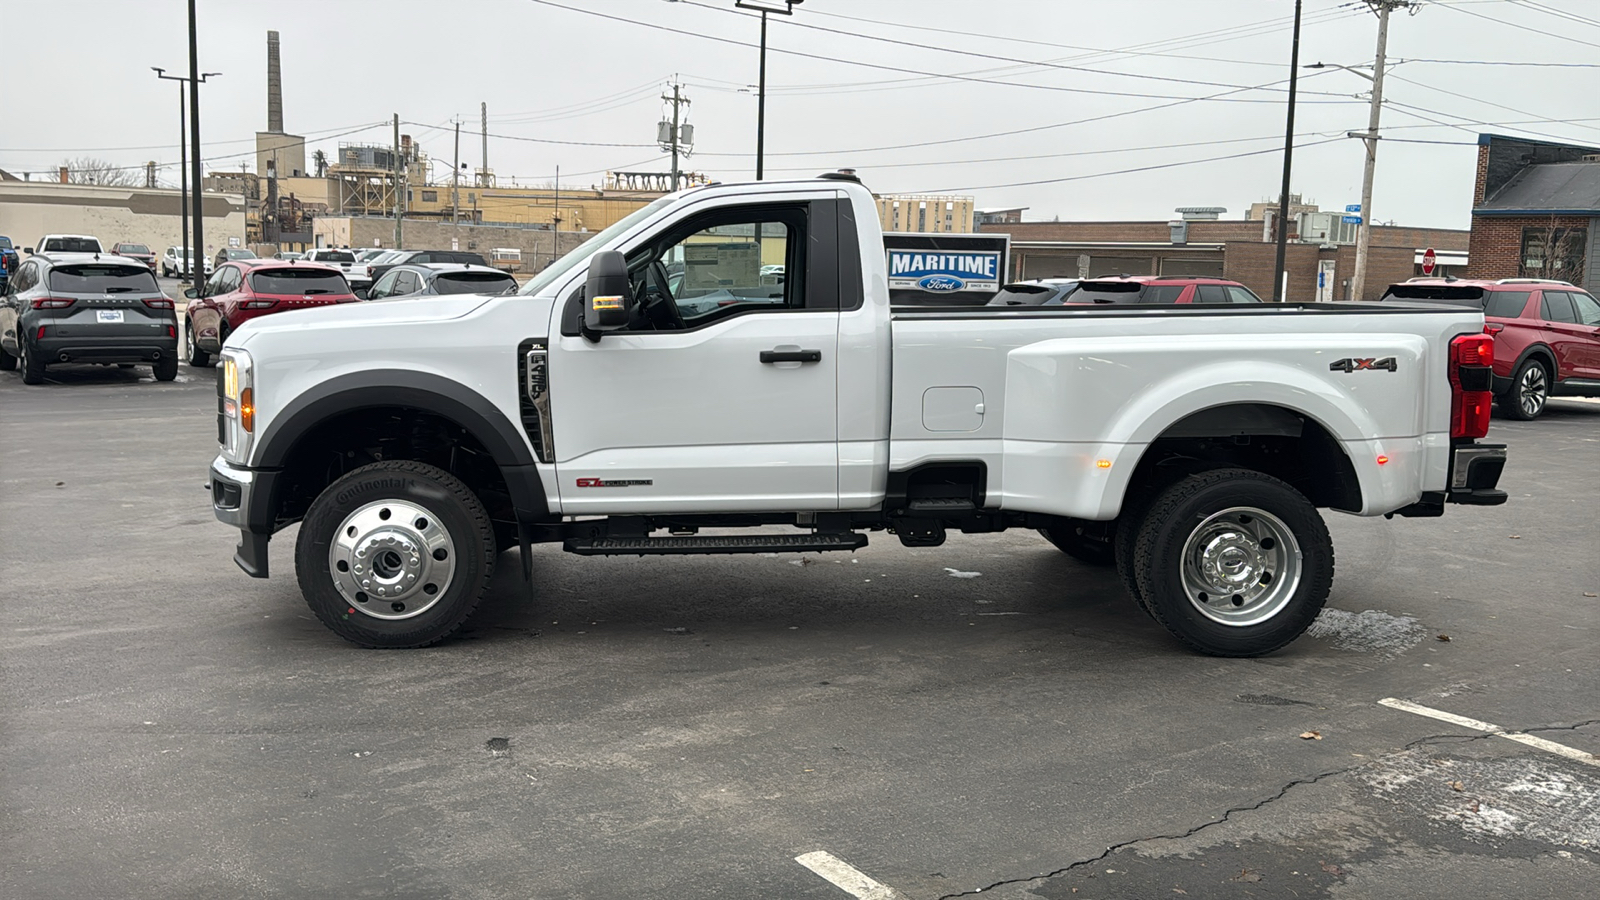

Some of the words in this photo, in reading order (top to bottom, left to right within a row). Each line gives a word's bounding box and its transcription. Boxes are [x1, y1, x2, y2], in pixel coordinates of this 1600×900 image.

[892, 254, 995, 277] MARITIME
[1423, 256, 1435, 266] STOP
[927, 278, 954, 290] Ford
[335, 477, 406, 505] Continental
